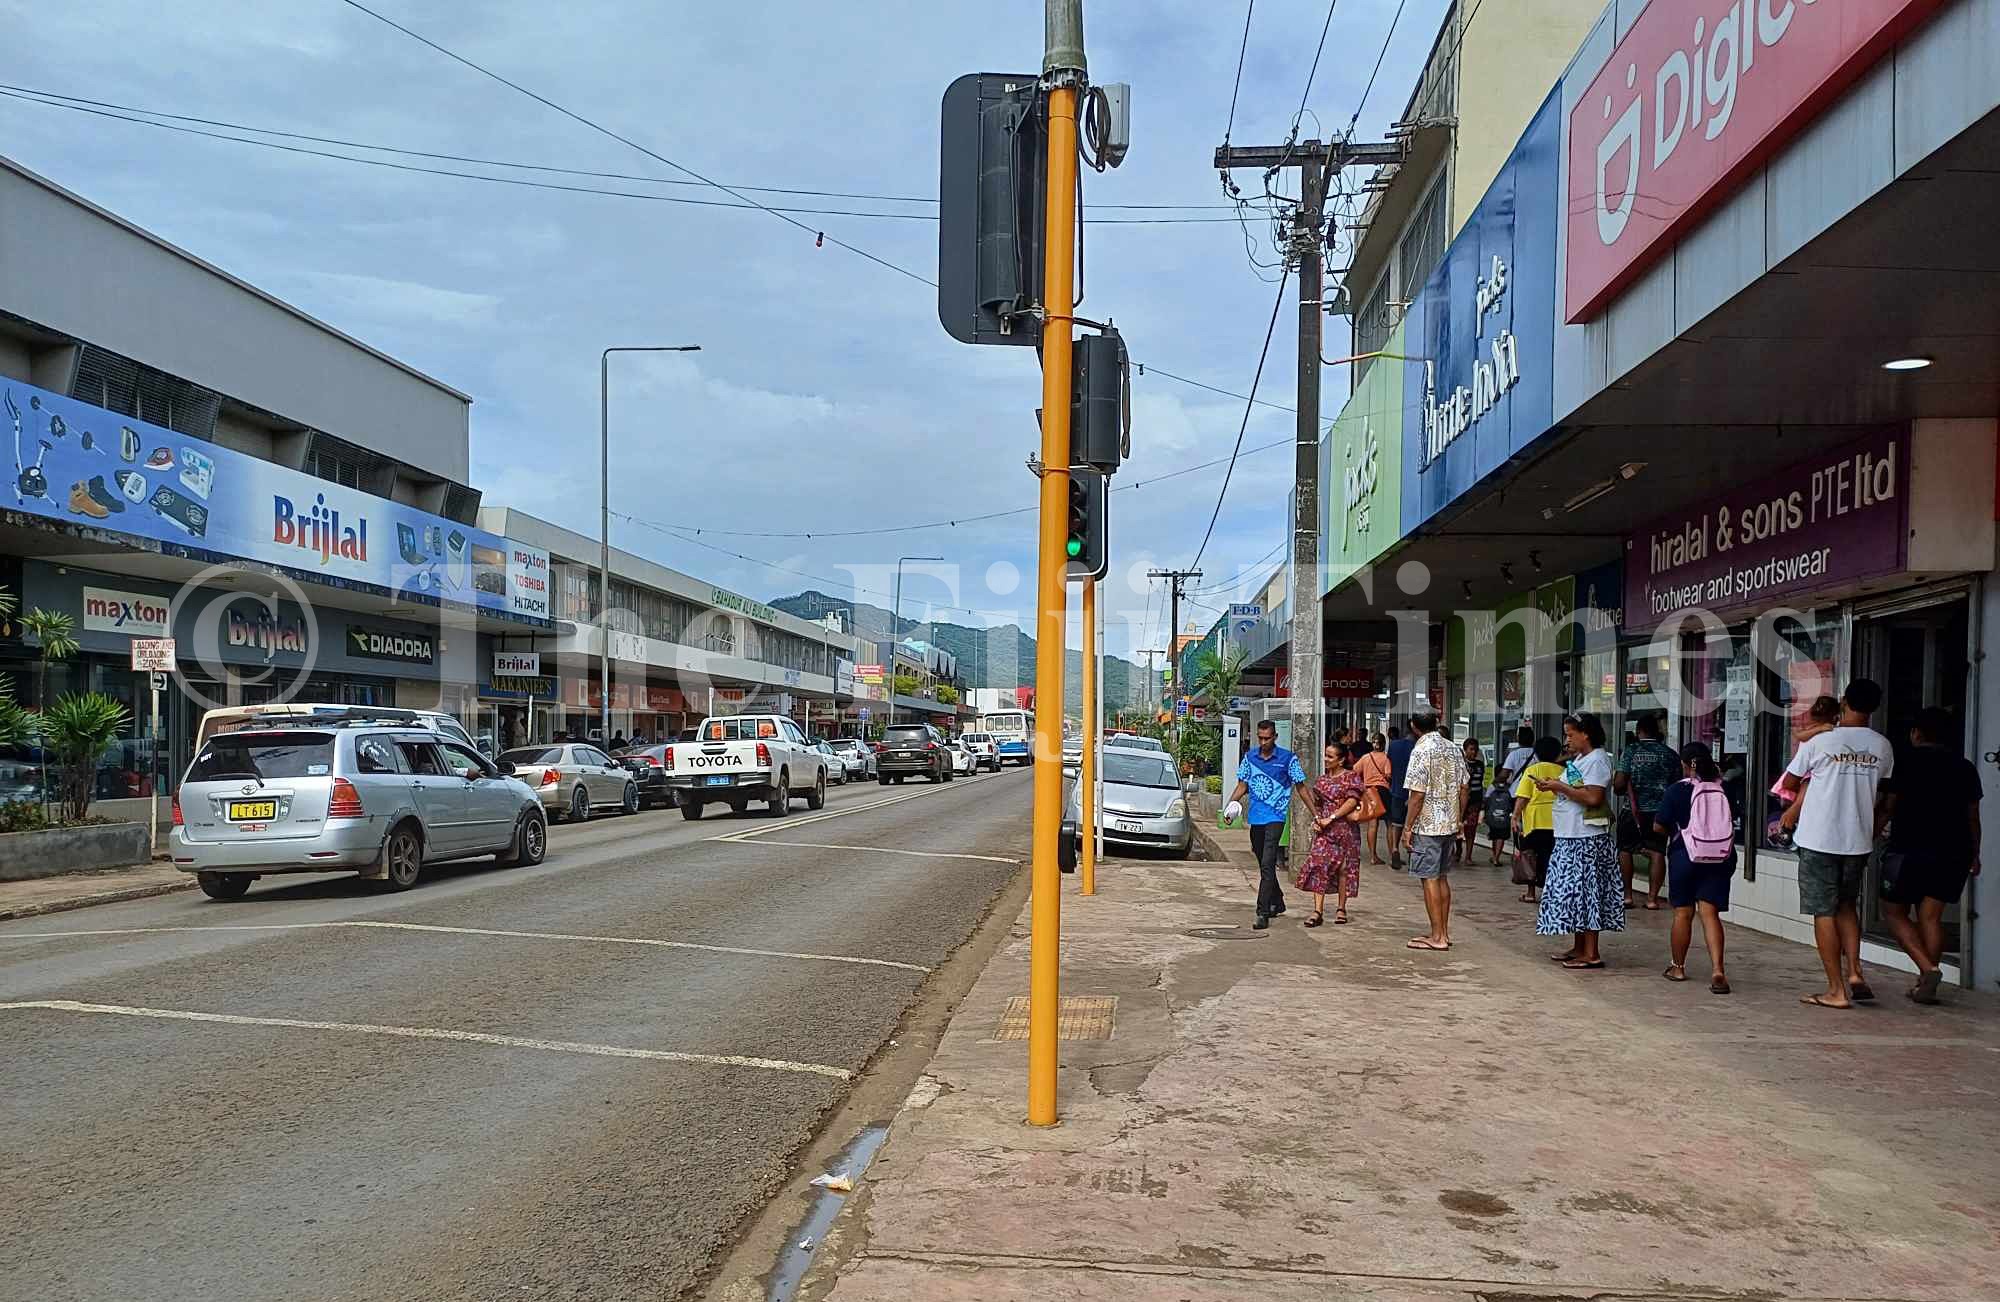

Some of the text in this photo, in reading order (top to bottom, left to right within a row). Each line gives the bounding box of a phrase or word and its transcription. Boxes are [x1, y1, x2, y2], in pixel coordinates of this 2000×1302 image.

[1650, 441, 1896, 575] hiralal & sons PTE ltd
[274, 493, 367, 566] Brijlal
[514, 550, 547, 570] maxton
[514, 574, 546, 593] TOSHIBA
[1651, 548, 1831, 616] footwear and sportswear
[86, 598, 168, 627] maxton
[514, 596, 546, 614] HITACHI
[370, 634, 432, 660] DIADORA
[498, 655, 535, 673] Brijlal
[688, 755, 743, 767] TOYOTA
[1832, 752, 1878, 764] APOLLO
